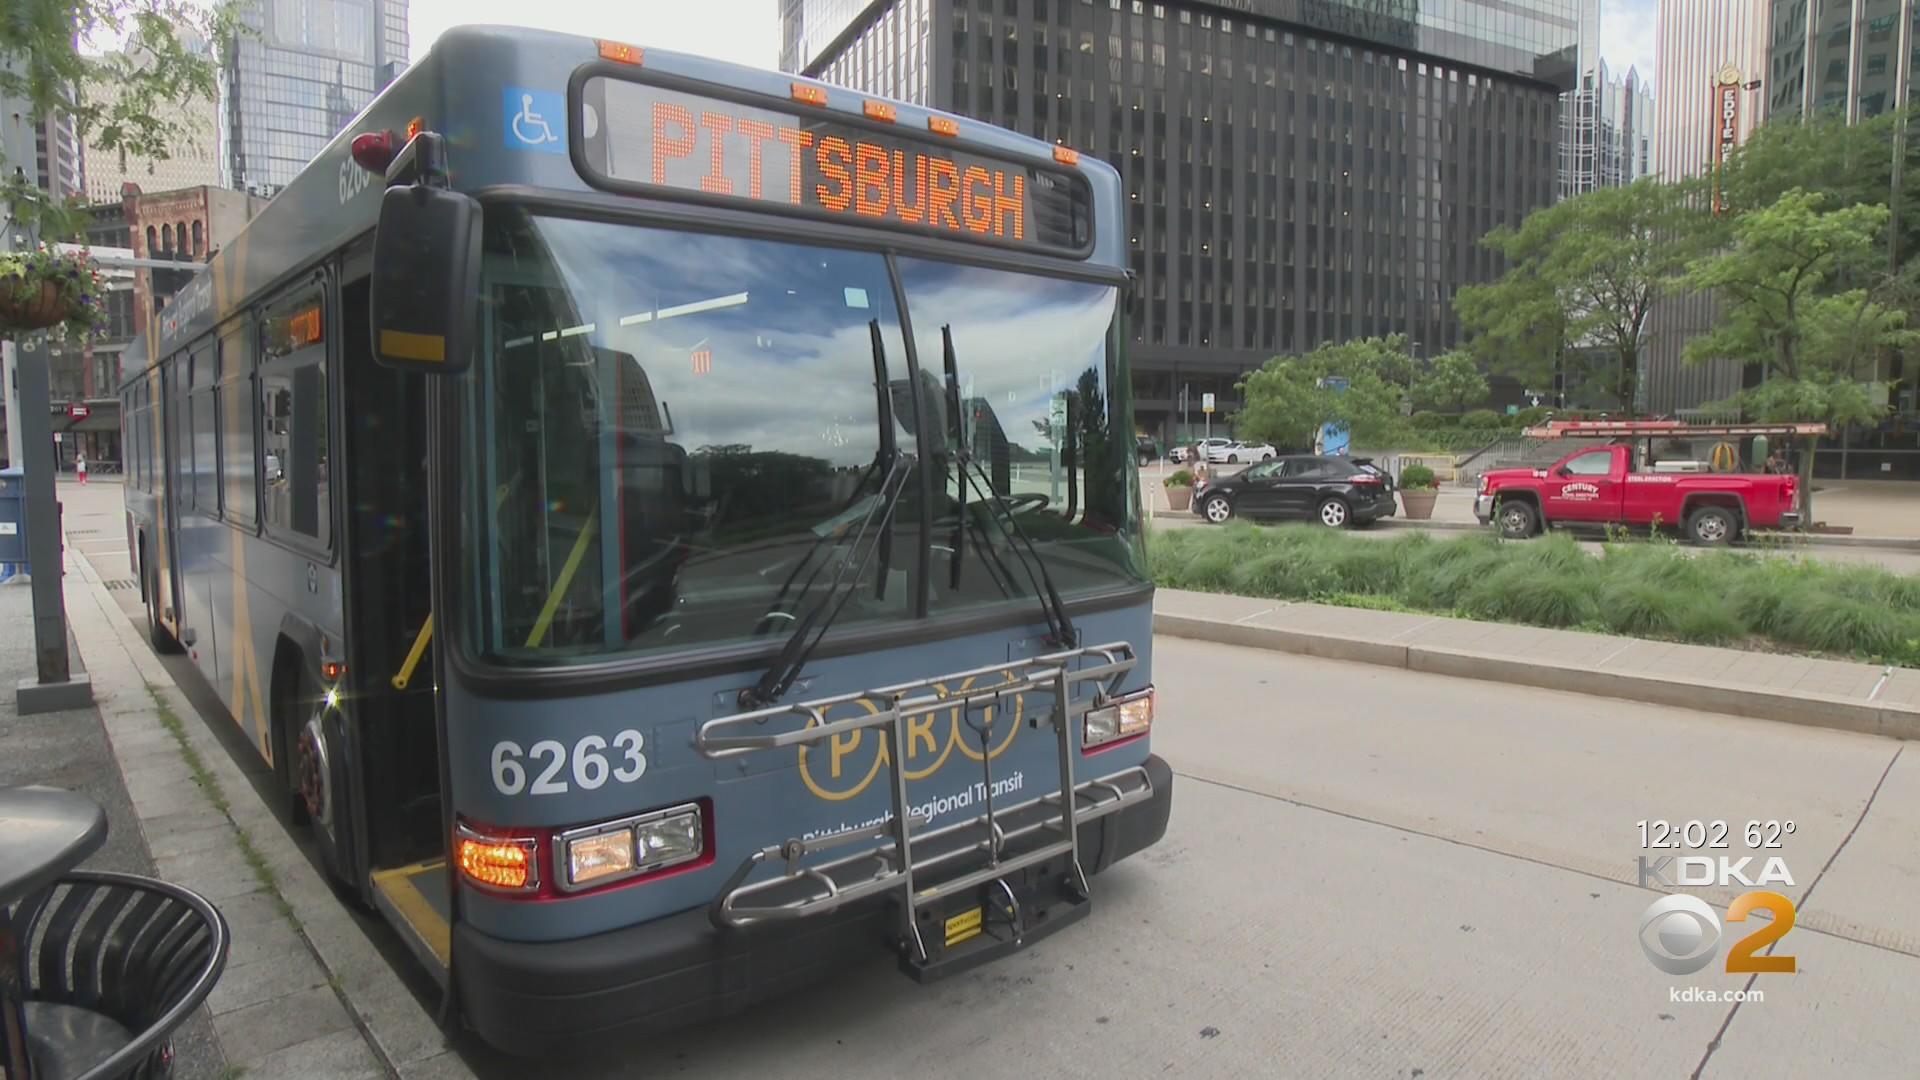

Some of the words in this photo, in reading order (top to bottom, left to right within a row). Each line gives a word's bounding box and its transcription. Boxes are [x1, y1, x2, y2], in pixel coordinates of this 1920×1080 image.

[1723, 90, 1735, 139] EDDIE
[651, 101, 1025, 240] PITTSBURGH
[1562, 483, 1599, 493] CENTURY
[491, 729, 647, 795] 6263
